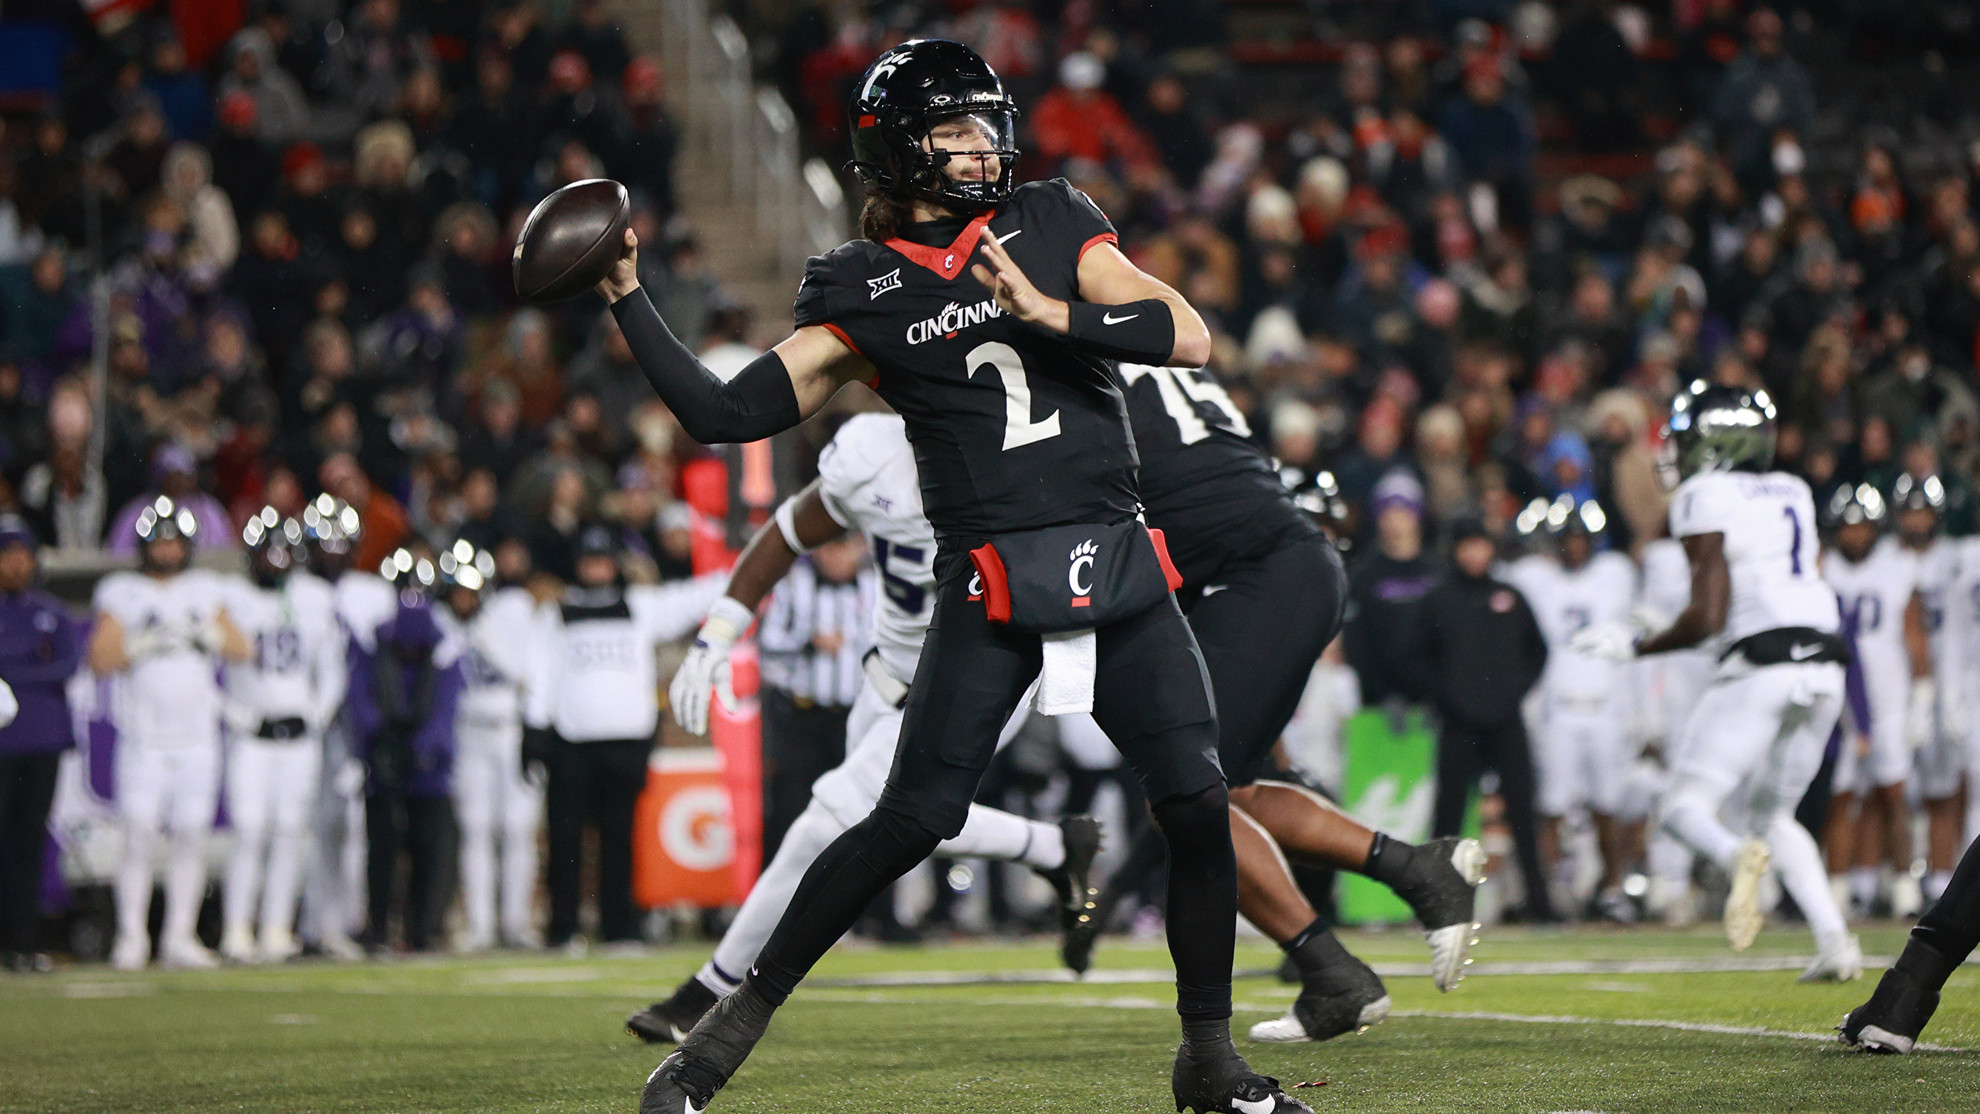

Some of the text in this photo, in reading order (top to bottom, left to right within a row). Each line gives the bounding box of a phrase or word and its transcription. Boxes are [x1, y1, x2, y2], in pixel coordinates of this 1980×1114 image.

[906, 299, 1010, 345] CINCINN
[965, 341, 1061, 451] 2
[1118, 362, 1252, 446] 75
[1068, 539, 1099, 596] C
[1783, 506, 1802, 575] 1
[658, 784, 737, 872] G
